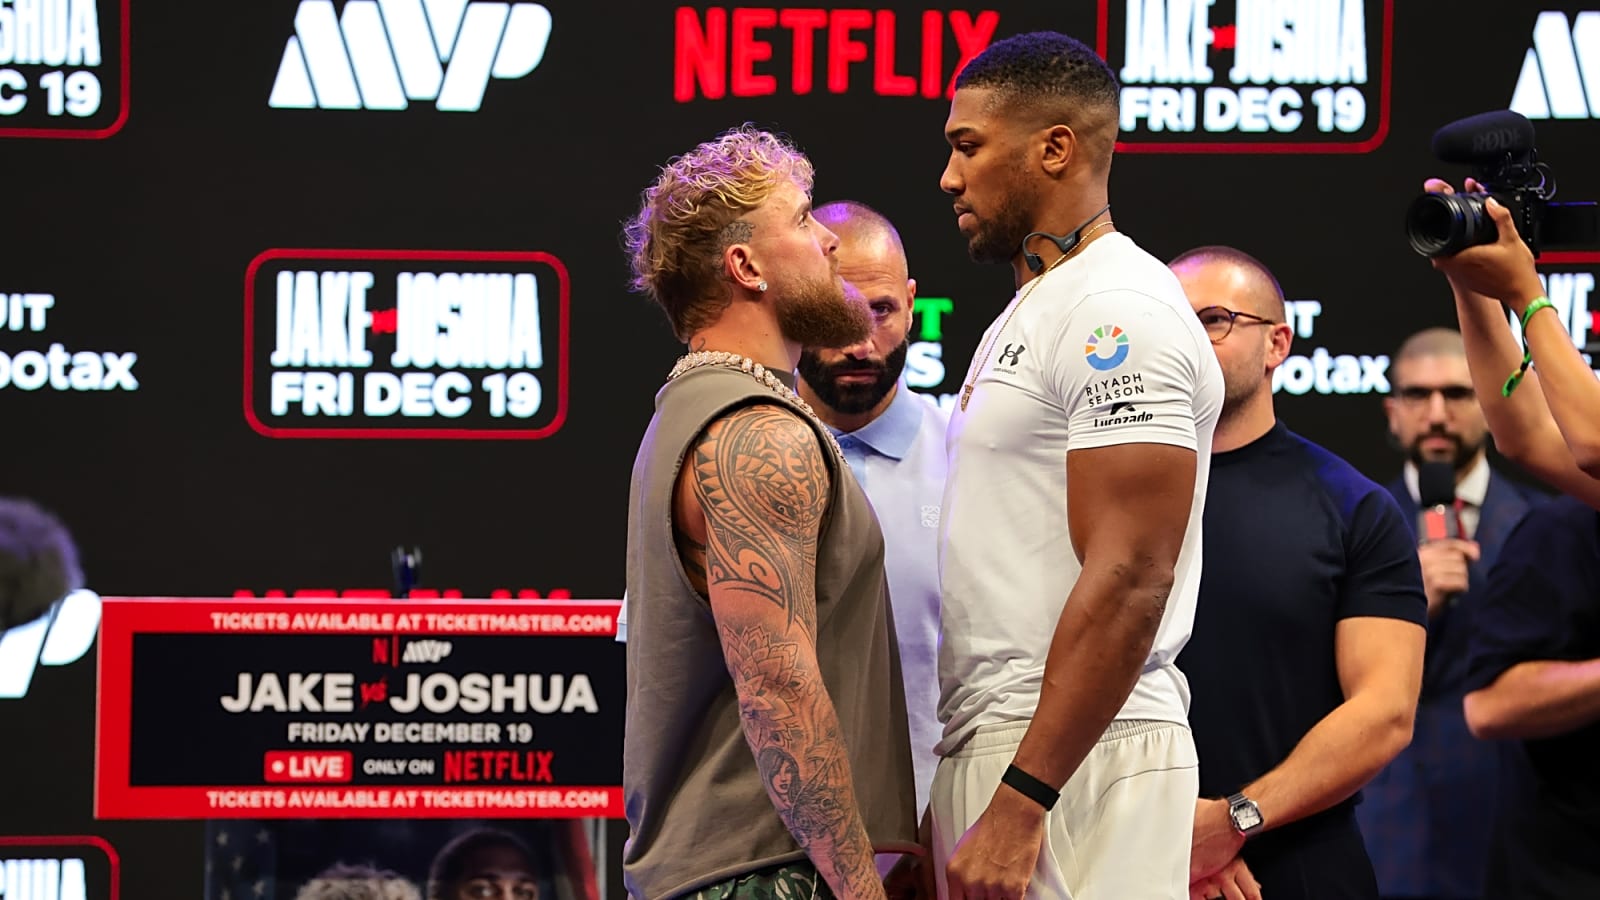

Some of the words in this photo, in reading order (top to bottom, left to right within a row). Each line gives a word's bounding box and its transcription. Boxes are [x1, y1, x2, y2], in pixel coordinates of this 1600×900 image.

[675, 7, 998, 101] NETFLIX
[1120, 0, 1213, 83] JAKE
[1229, 0, 1367, 84] JOSHUA
[40, 71, 101, 116] 19
[1119, 87, 1196, 131] FRI
[1204, 87, 1302, 131] DEC
[1312, 87, 1365, 131] 19
[0, 294, 54, 330] IT
[271, 271, 373, 366] JAKE
[391, 272, 542, 369] JOSHUA
[0, 343, 138, 390] otax
[1086, 373, 1142, 397] RIYADH
[1272, 346, 1393, 396] otax
[271, 372, 353, 415] FRI
[364, 372, 471, 417] DEC
[482, 372, 541, 417] 19
[1089, 385, 1144, 408] SEASON
[210, 612, 290, 630] TICKETS
[291, 613, 394, 631] AVAILABLE
[396, 614, 423, 631] AT
[425, 614, 612, 633] TICKETMASTER.COM
[221, 674, 353, 712] JAKE
[390, 674, 598, 713] JOSHUA
[288, 723, 369, 742] FRIDAY
[375, 723, 500, 742] DECEMBER
[507, 724, 532, 742] 19
[289, 756, 344, 778] LIVE
[364, 760, 406, 774] ONLY
[409, 760, 434, 774] ON
[443, 751, 554, 782] NETFLIX
[206, 791, 286, 808] TICKETS
[287, 791, 391, 808] AVAILABLE
[392, 791, 420, 808] AT
[421, 791, 609, 809] TICKETMASTER.COM
